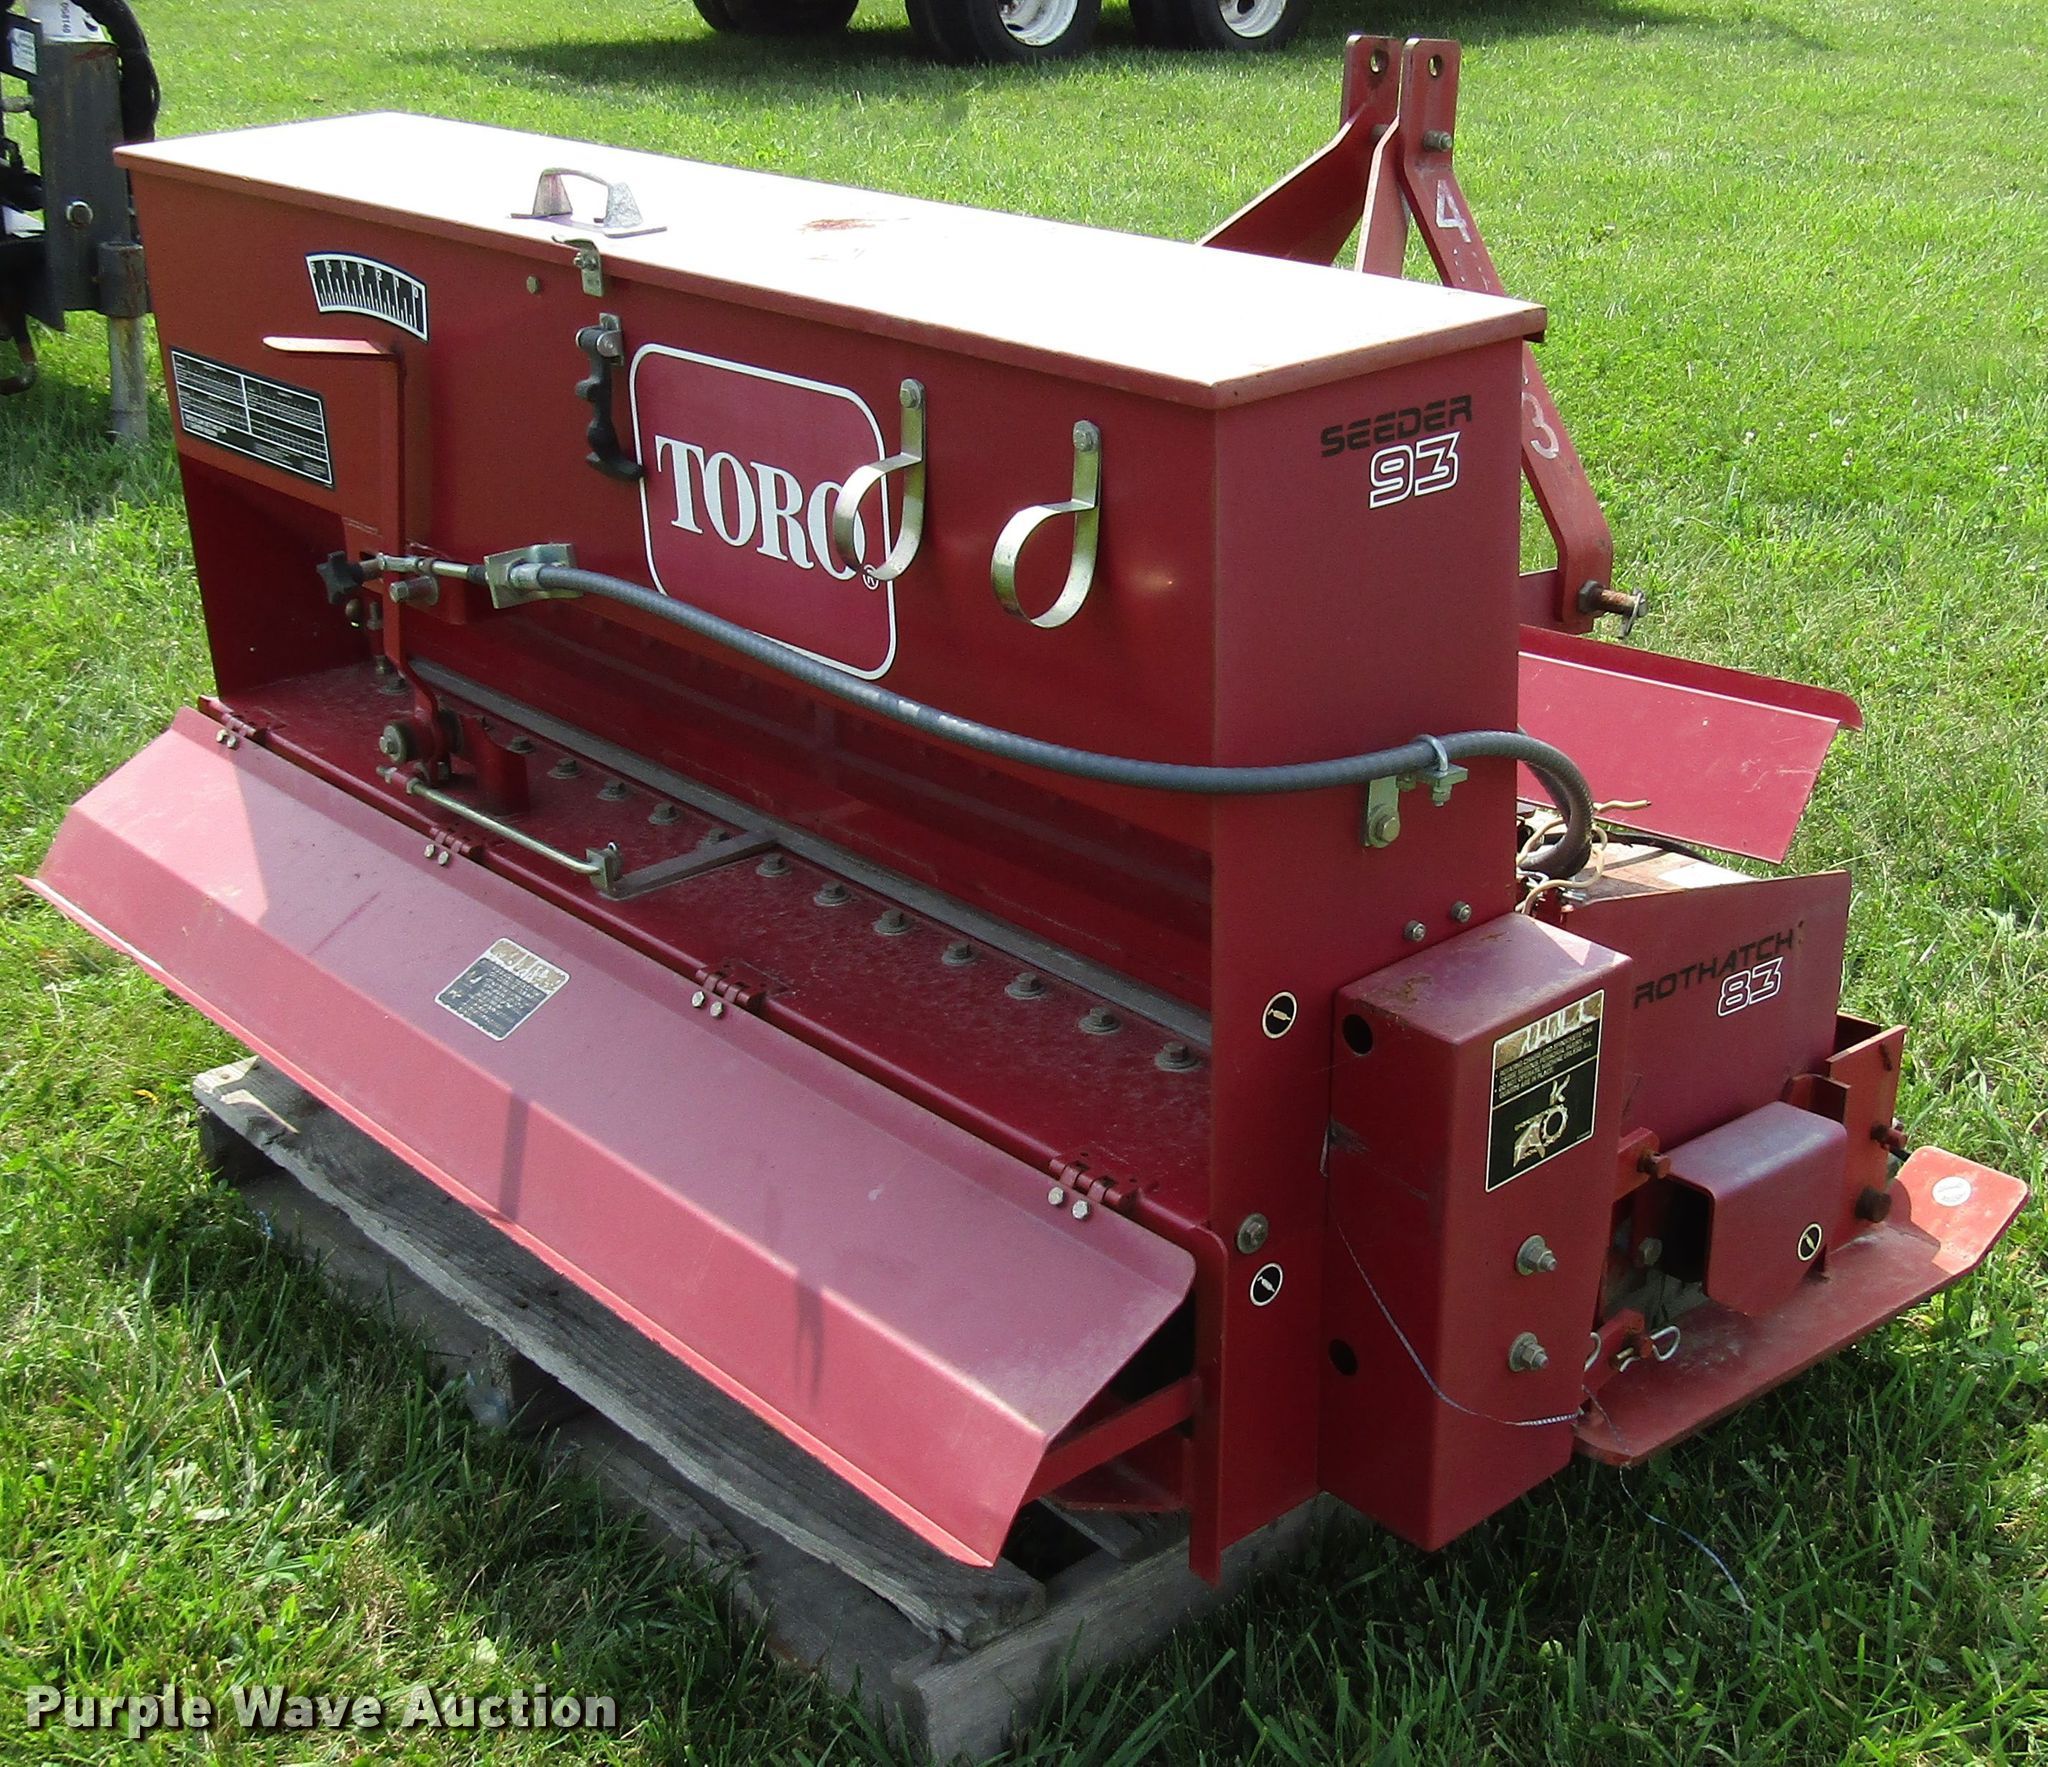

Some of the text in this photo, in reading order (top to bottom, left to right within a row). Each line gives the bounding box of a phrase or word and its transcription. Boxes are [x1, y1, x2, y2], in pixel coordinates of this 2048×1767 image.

[1436, 179, 1471, 243] 4
[1320, 394, 1473, 458] SEEDER
[1368, 430, 1461, 510] 93
[654, 434, 867, 581] TORO
[1716, 956, 1784, 1017] 83
